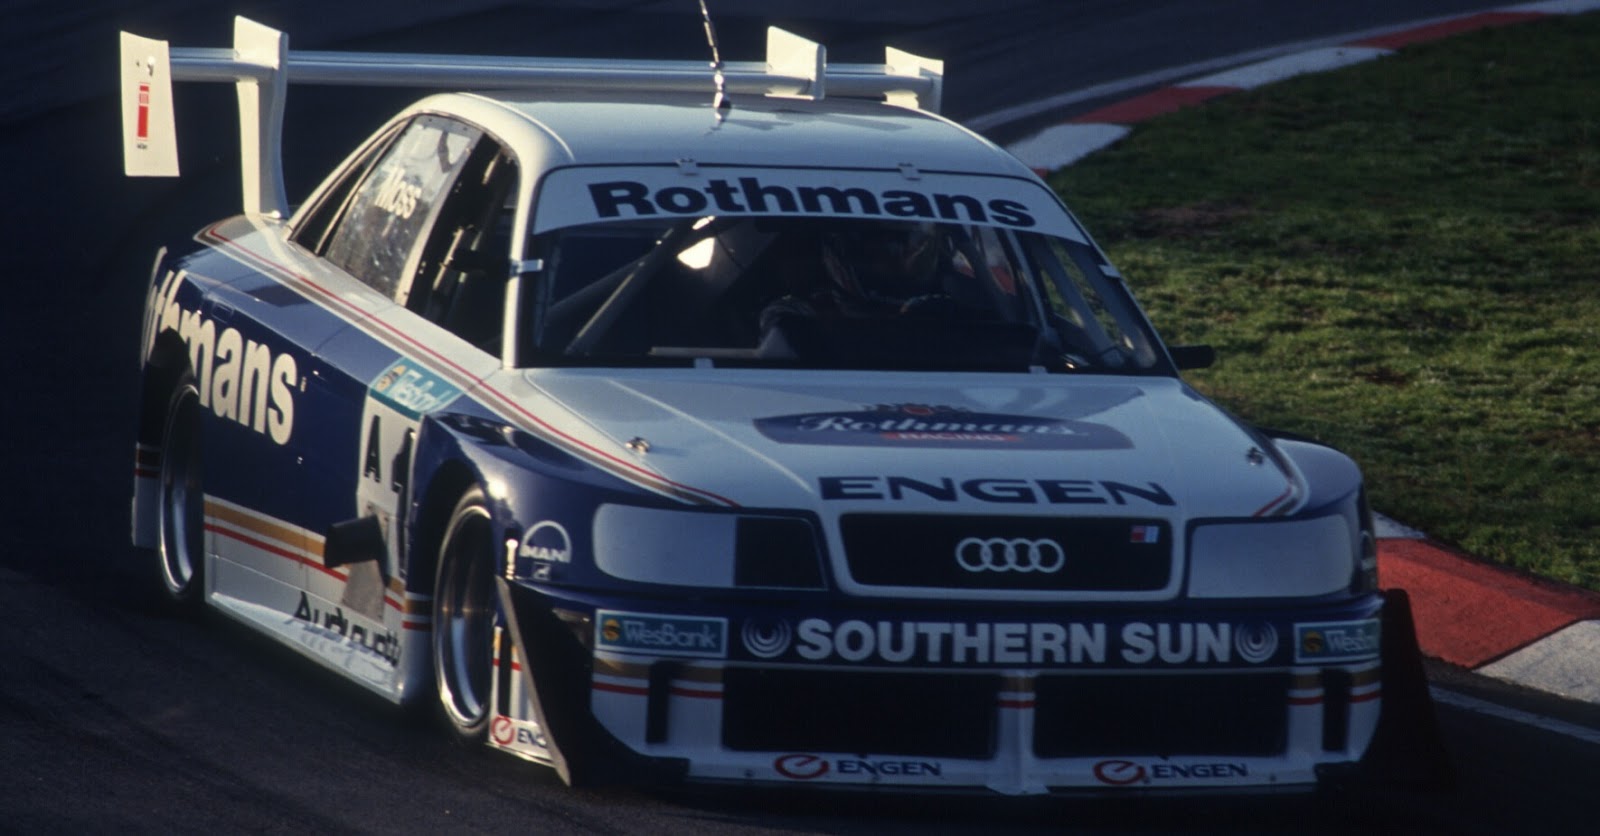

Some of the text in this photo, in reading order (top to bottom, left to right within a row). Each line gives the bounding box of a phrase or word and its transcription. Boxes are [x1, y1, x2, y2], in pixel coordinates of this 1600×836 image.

[374, 166, 422, 219] Moss
[587, 176, 1037, 228] Rothmans
[798, 416, 1090, 436] Rothmans
[898, 431, 1007, 442] RACING
[364, 414, 381, 484] A
[817, 475, 1177, 507] ENGEN
[519, 545, 572, 564] MAN
[622, 619, 718, 649] WesBank
[796, 618, 1231, 664] SOUTHERN SUN
[836, 758, 942, 777] ENGEN
[1151, 762, 1249, 779] ENGEN
